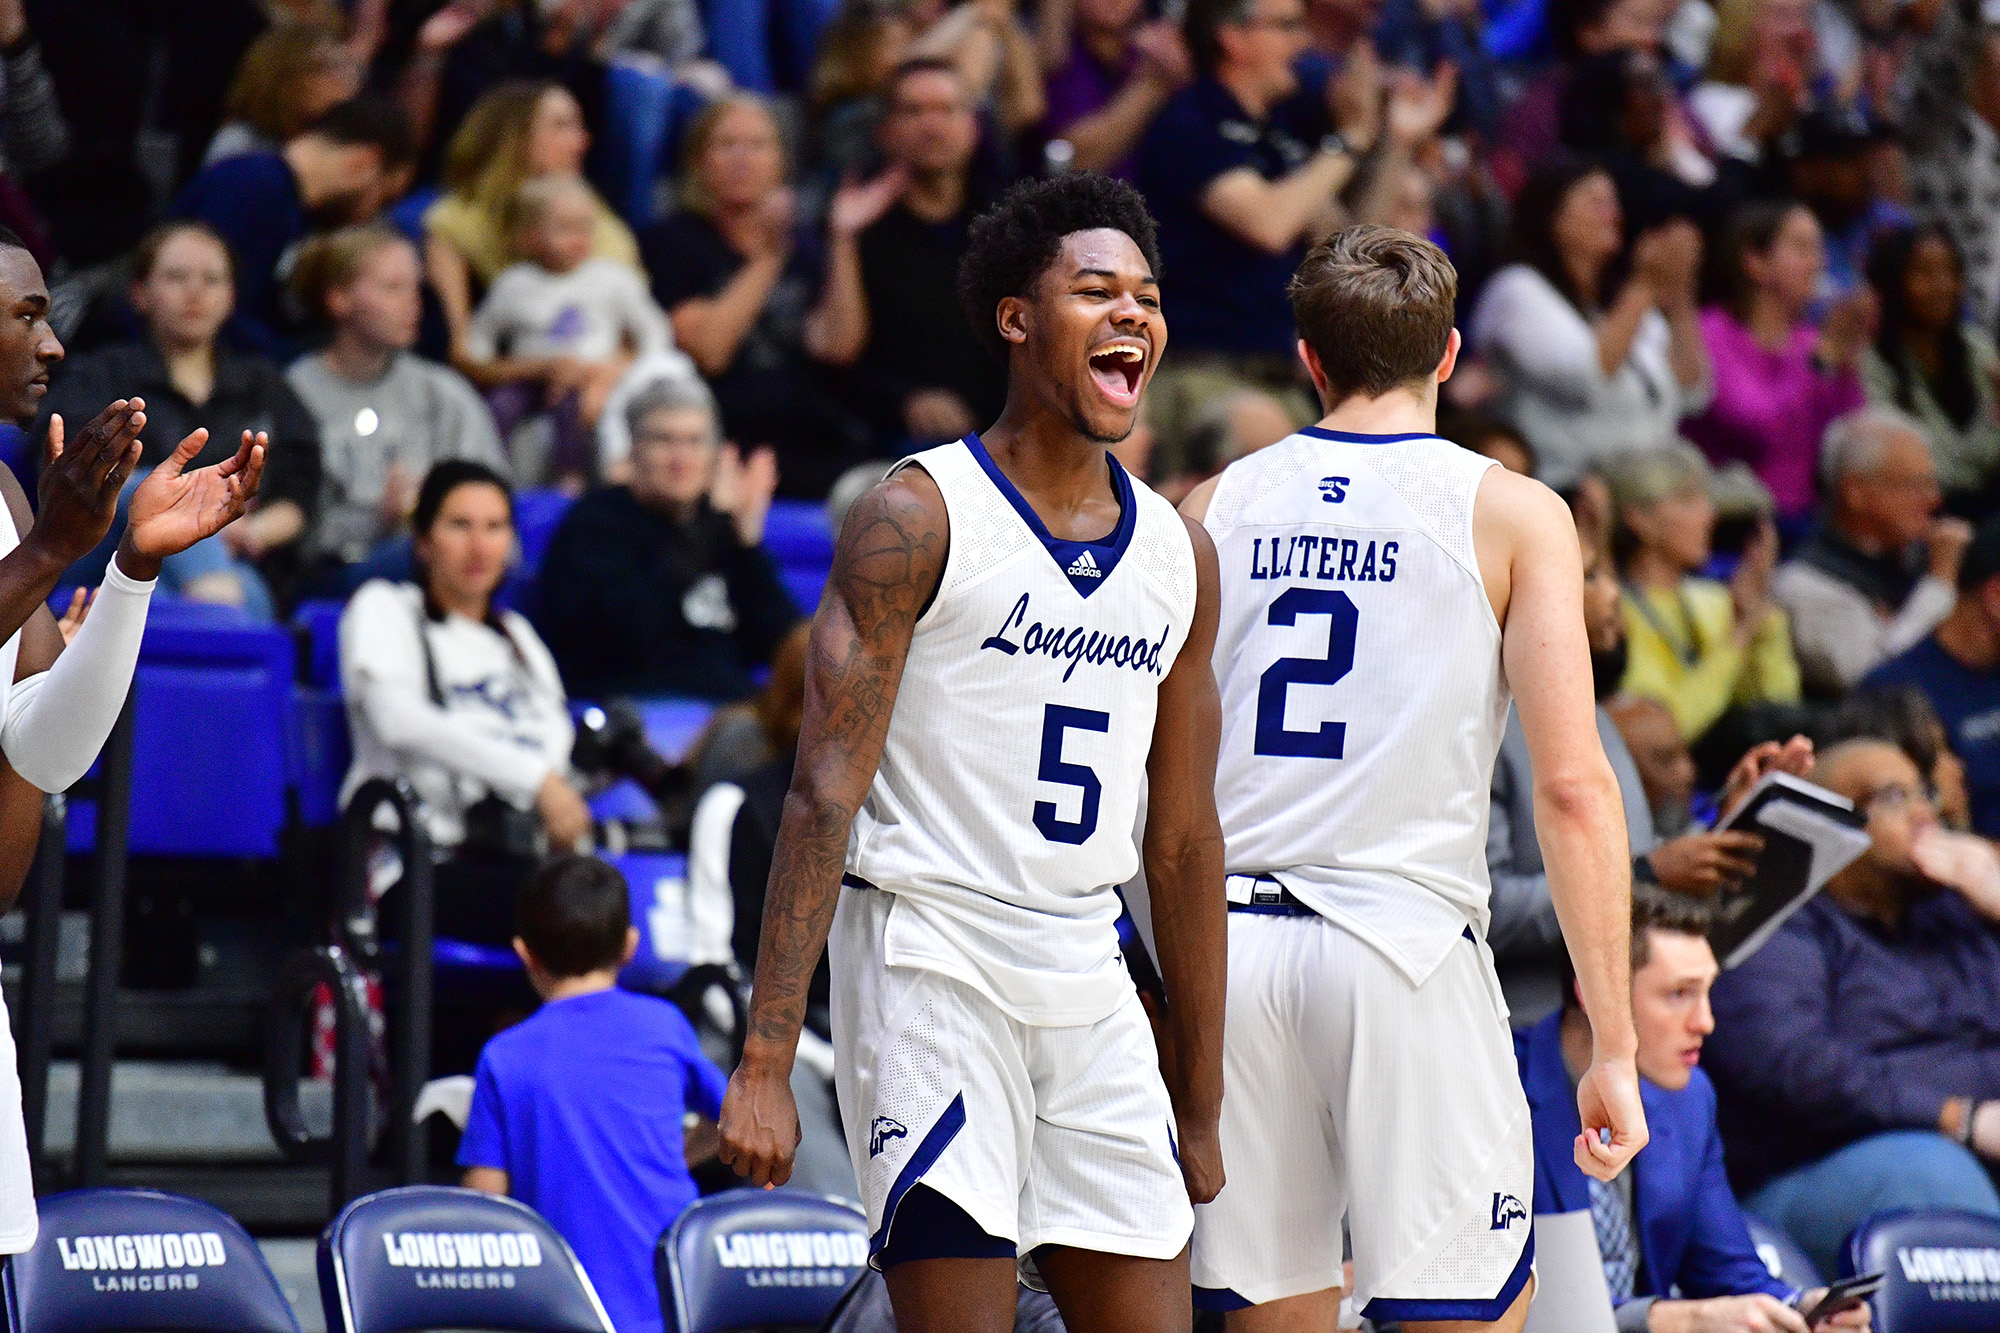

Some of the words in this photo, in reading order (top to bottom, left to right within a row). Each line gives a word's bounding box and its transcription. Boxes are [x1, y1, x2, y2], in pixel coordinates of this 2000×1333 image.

[1067, 565, 1102, 578] adidas
[979, 592, 1170, 683] Longwood
[1254, 587, 1359, 760] 2
[1032, 703, 1110, 846] 5
[56, 1232, 227, 1270] LONGWOOD
[382, 1232, 542, 1268] LONGWOOD
[714, 1231, 869, 1268] LONGWOOD
[93, 1273, 200, 1292] LANCERS
[415, 1271, 516, 1289] LANCERS
